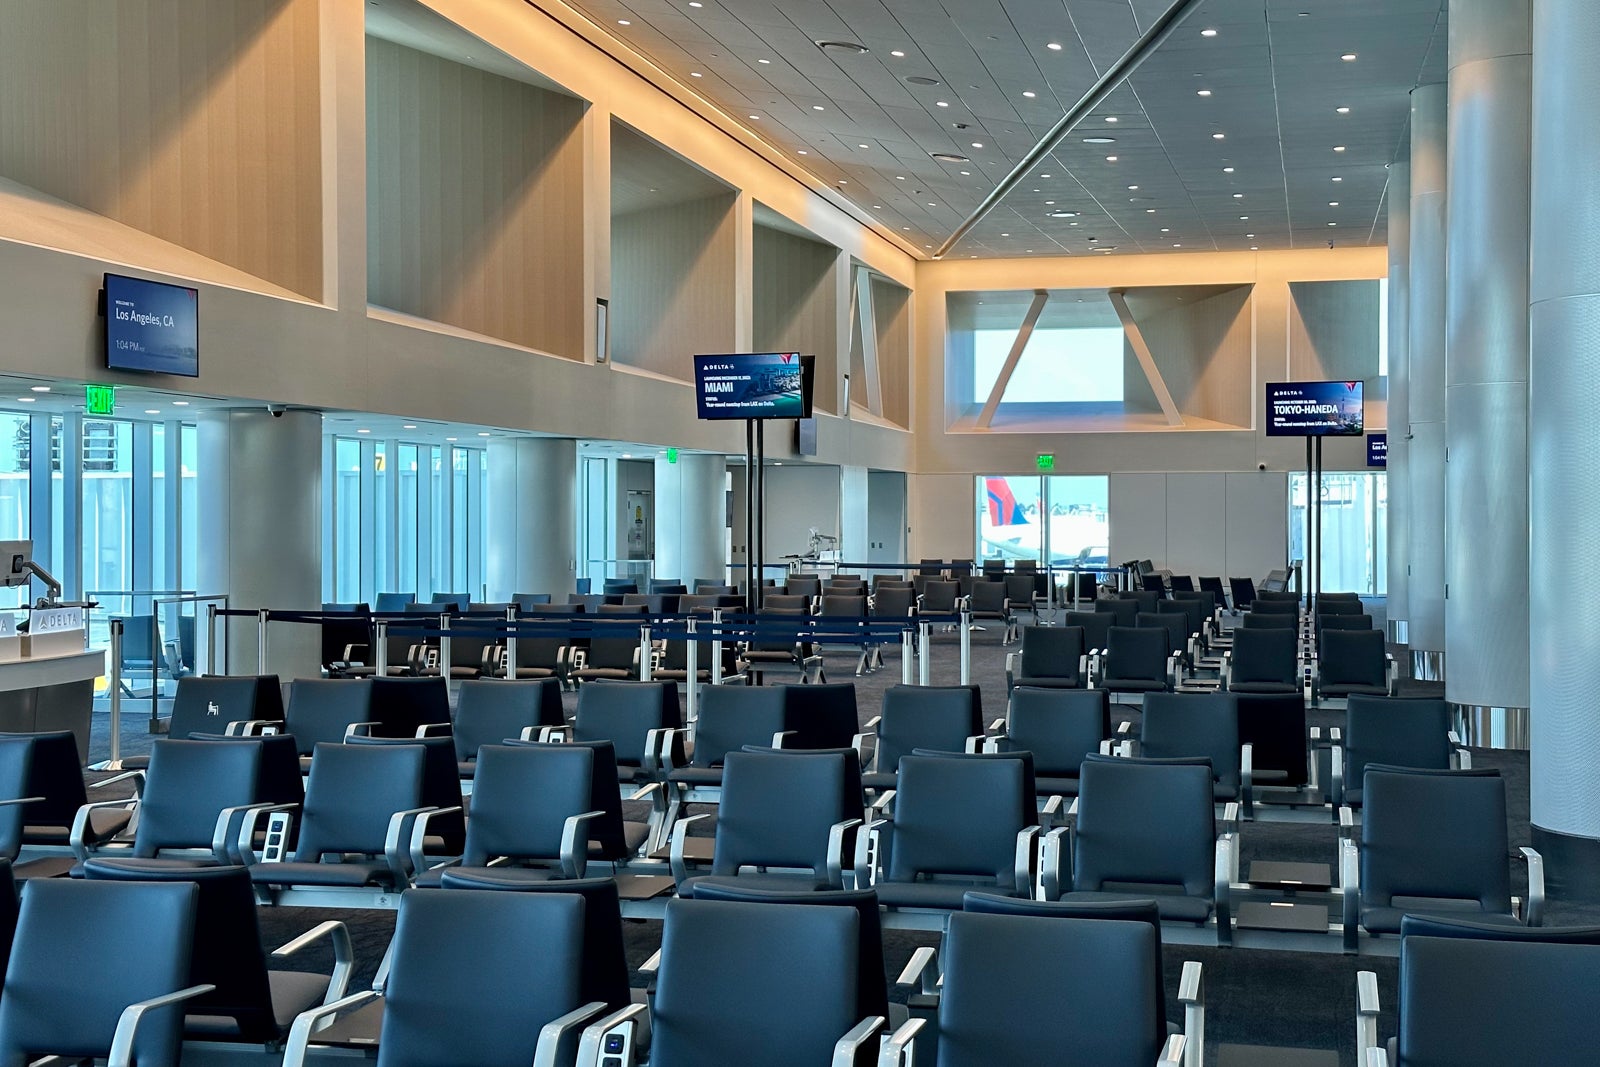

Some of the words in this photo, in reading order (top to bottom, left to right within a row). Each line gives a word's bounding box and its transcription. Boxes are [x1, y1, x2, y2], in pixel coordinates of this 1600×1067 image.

[116, 308, 128, 320] Los
[130, 310, 162, 327] Angeles,
[163, 315, 174, 327] CA
[116, 340, 128, 350] 1:04
[129, 341, 139, 350] PM
[705, 382, 733, 392] MIAMI
[1274, 404, 1338, 414] TOKYO-HANEDA
[376, 456, 382, 471] 7
[50, 614, 77, 627] DELTA
